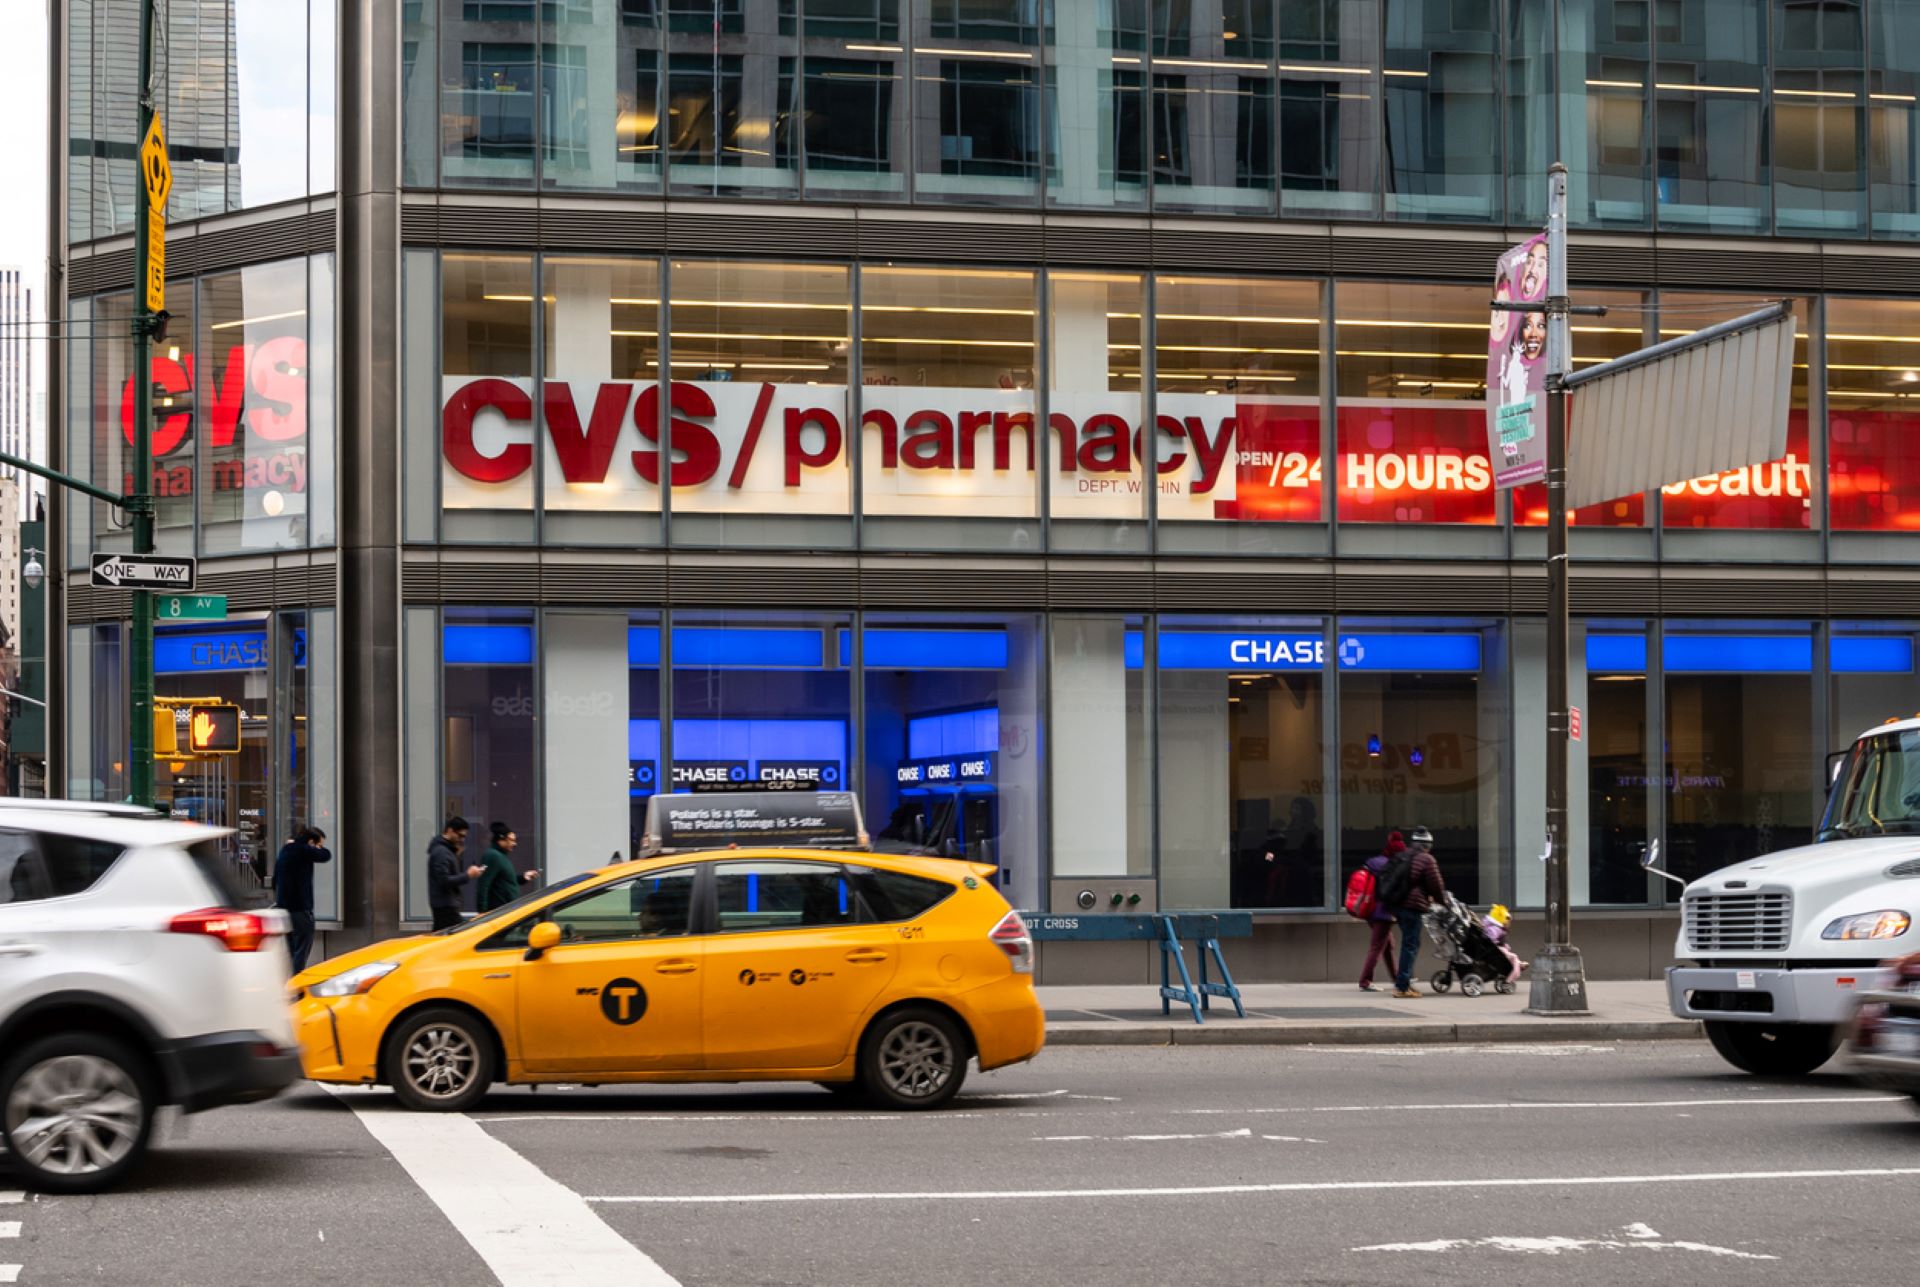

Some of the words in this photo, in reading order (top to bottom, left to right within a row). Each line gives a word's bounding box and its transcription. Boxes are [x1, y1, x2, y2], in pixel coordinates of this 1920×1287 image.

[121, 336, 306, 457] CVS
[124, 453, 306, 496] hamacy
[1347, 453, 1491, 491] HOURS
[1661, 453, 1811, 508] eaut
[1079, 479, 1123, 493] DEPT.
[1127, 480, 1180, 494] WHIN
[103, 564, 136, 578] ONE
[153, 566, 186, 580] WAY
[169, 598, 182, 617] 8
[196, 598, 213, 609] AV
[1230, 639, 1330, 664] CHASE
[760, 768, 819, 782] CHASE
[670, 808, 710, 820] Polaris
[711, 808, 722, 819] is
[724, 810, 732, 819] a
[733, 808, 759, 819] star.
[670, 820, 693, 831] The
[694, 819, 735, 831] Polaris
[736, 818, 774, 830] lounge
[776, 817, 788, 828] is
[789, 816, 827, 828] 5-star.
[1044, 918, 1079, 930] CROSS
[611, 987, 637, 1019] T
